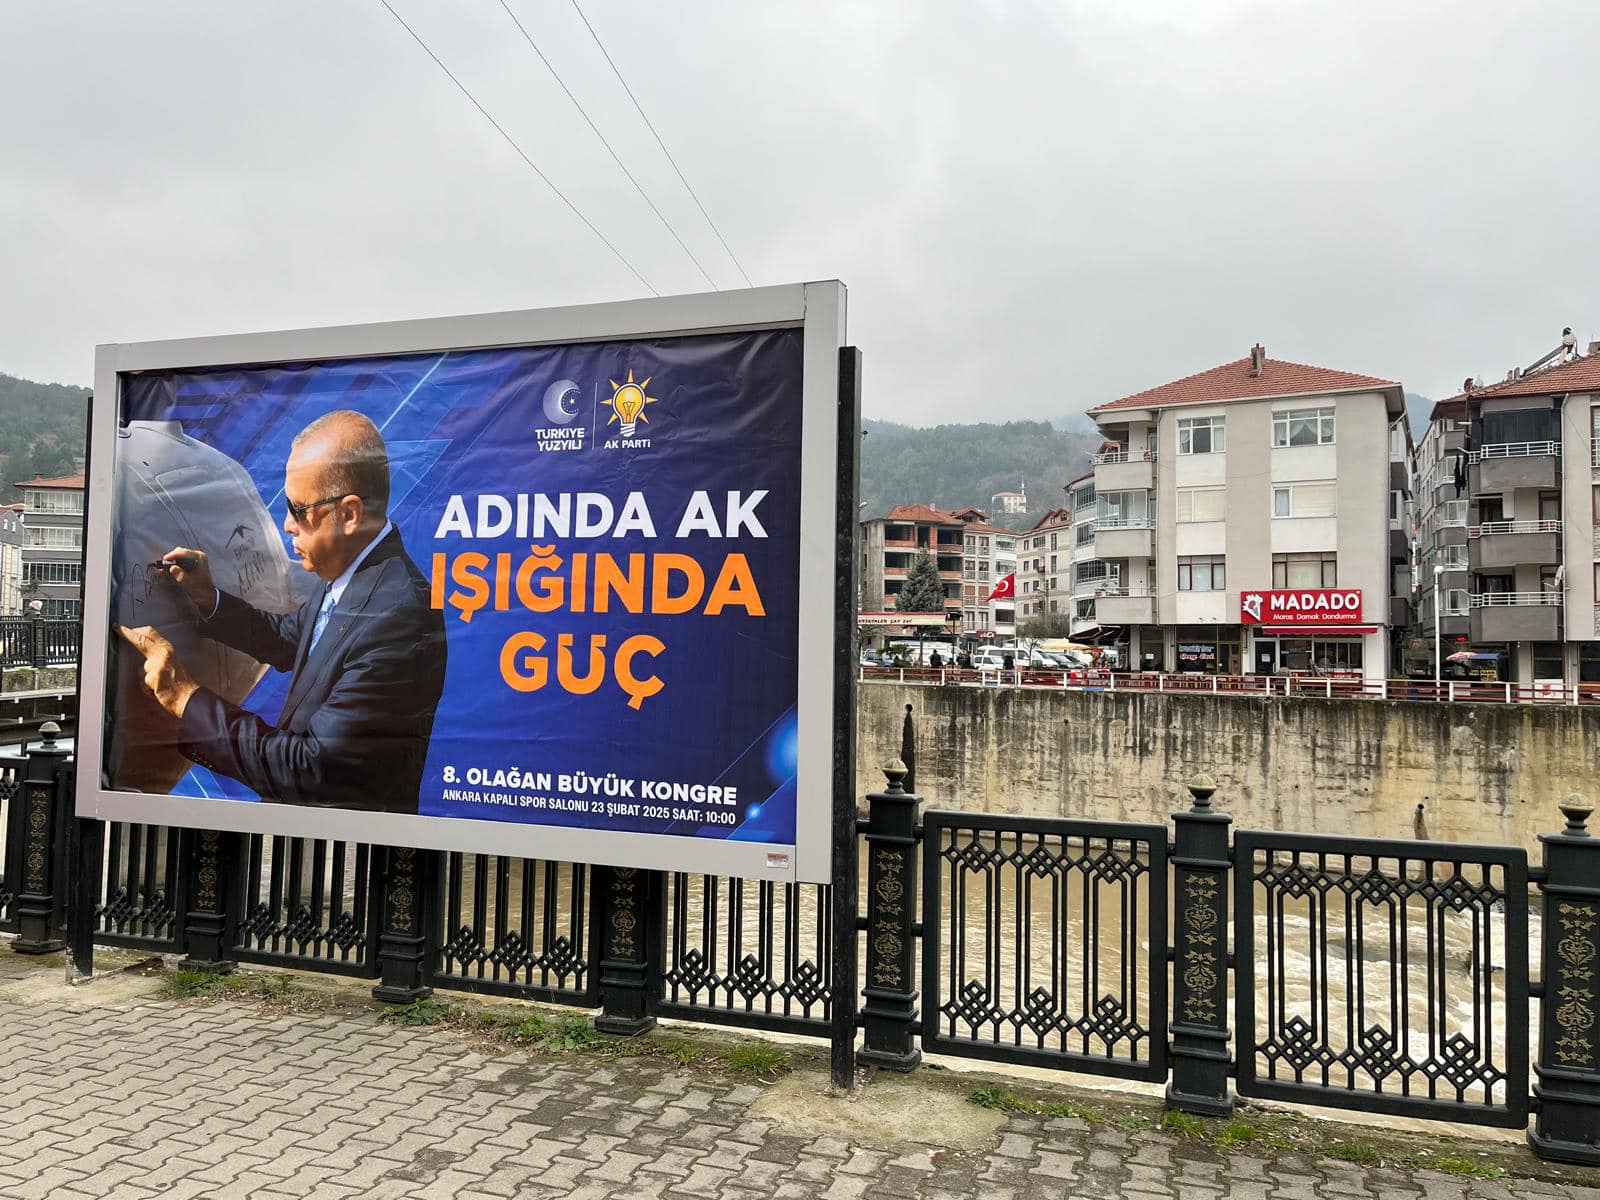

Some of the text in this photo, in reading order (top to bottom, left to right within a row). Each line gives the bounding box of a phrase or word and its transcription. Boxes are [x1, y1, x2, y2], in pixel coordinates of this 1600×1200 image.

[603, 439, 619, 449] AK
[434, 489, 770, 538] ADINDA AK
[430, 544, 767, 623] IŞIĞINDA
[1270, 593, 1360, 611] MADADO
[499, 631, 666, 711] GÜÇ
[442, 765, 737, 806] 8. OLAĞAN BÜYÜK KONGRE
[442, 788, 736, 825] ANKARA KAPALI SPOR SALONU 23 ŞUBAT 2025 SAAT: 10:00
